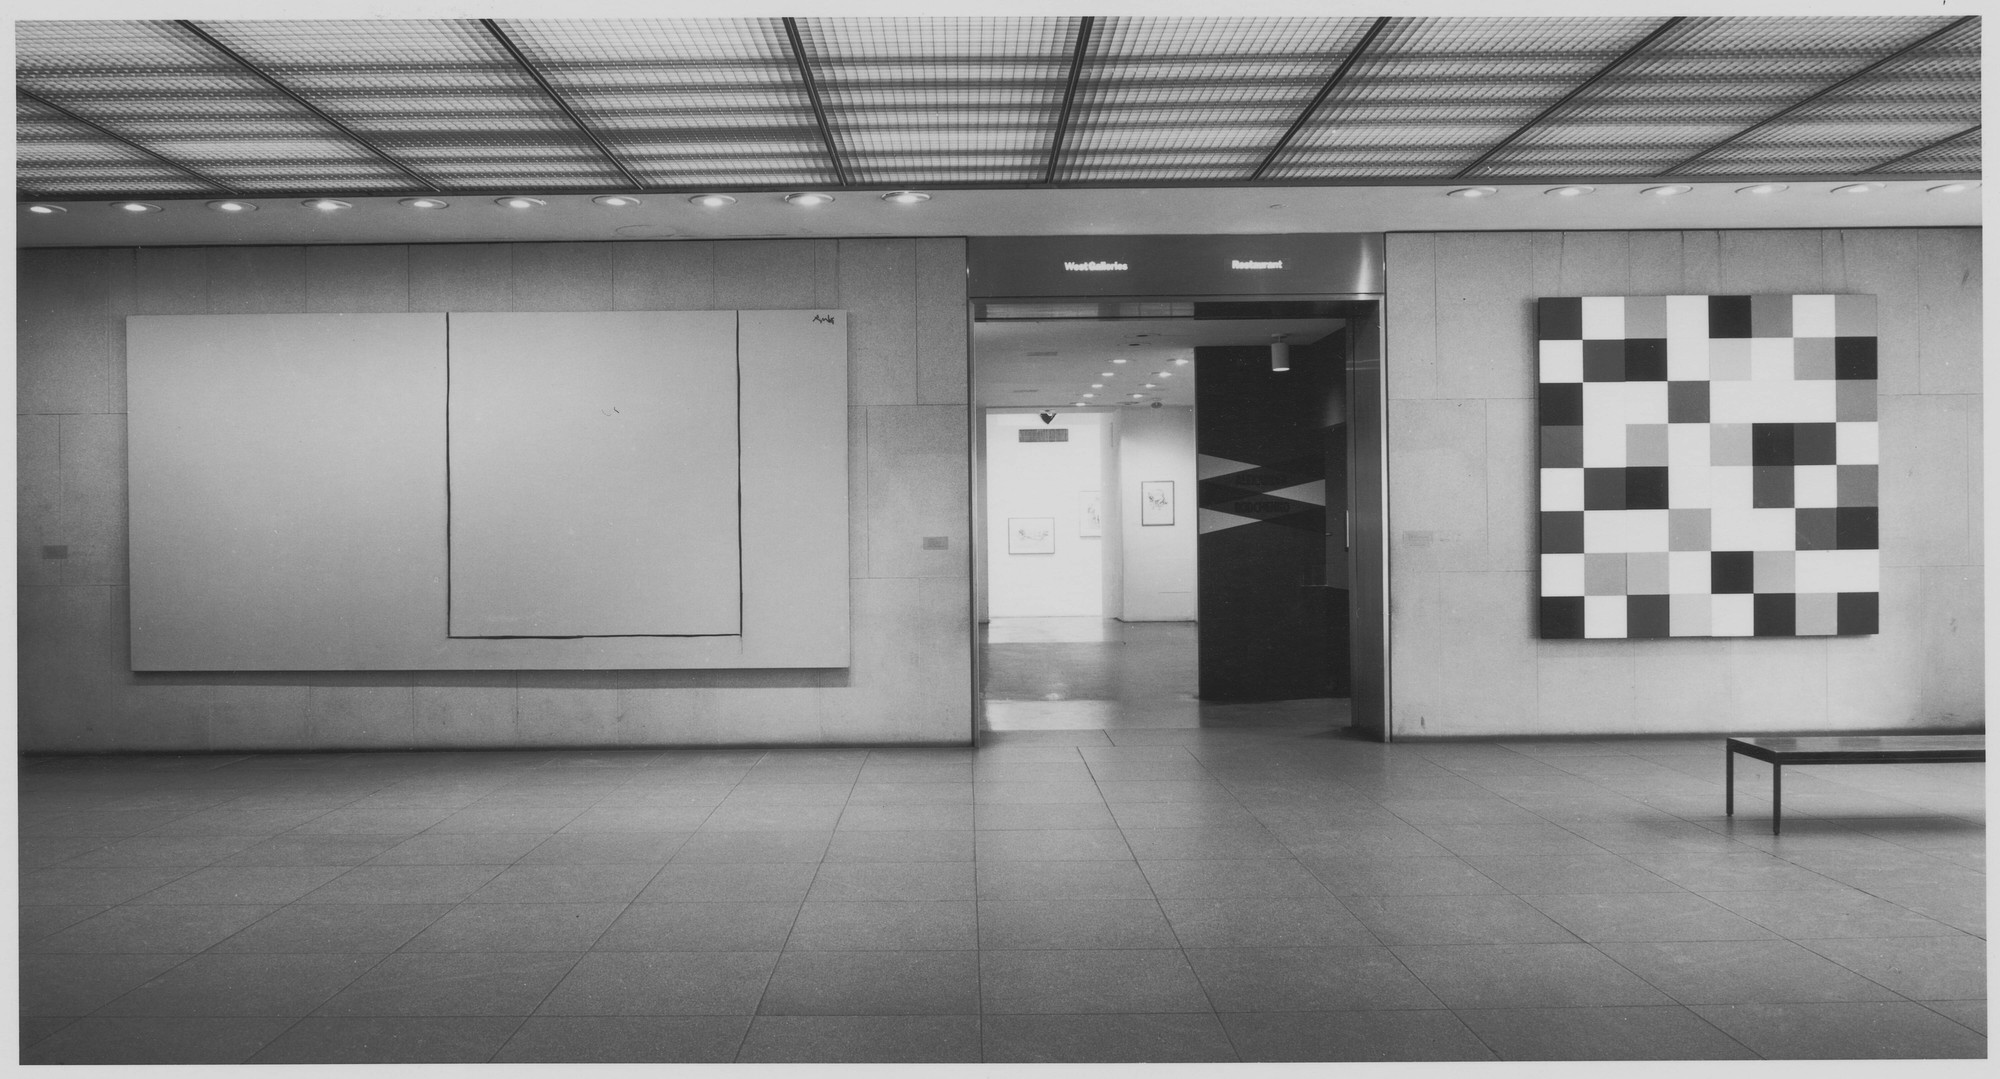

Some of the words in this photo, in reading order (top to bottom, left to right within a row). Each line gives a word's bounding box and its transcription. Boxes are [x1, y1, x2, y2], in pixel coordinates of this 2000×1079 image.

[1064, 261, 1088, 271] West
[1089, 261, 1128, 271] Galleries
[1232, 260, 1283, 269] Restaurant
